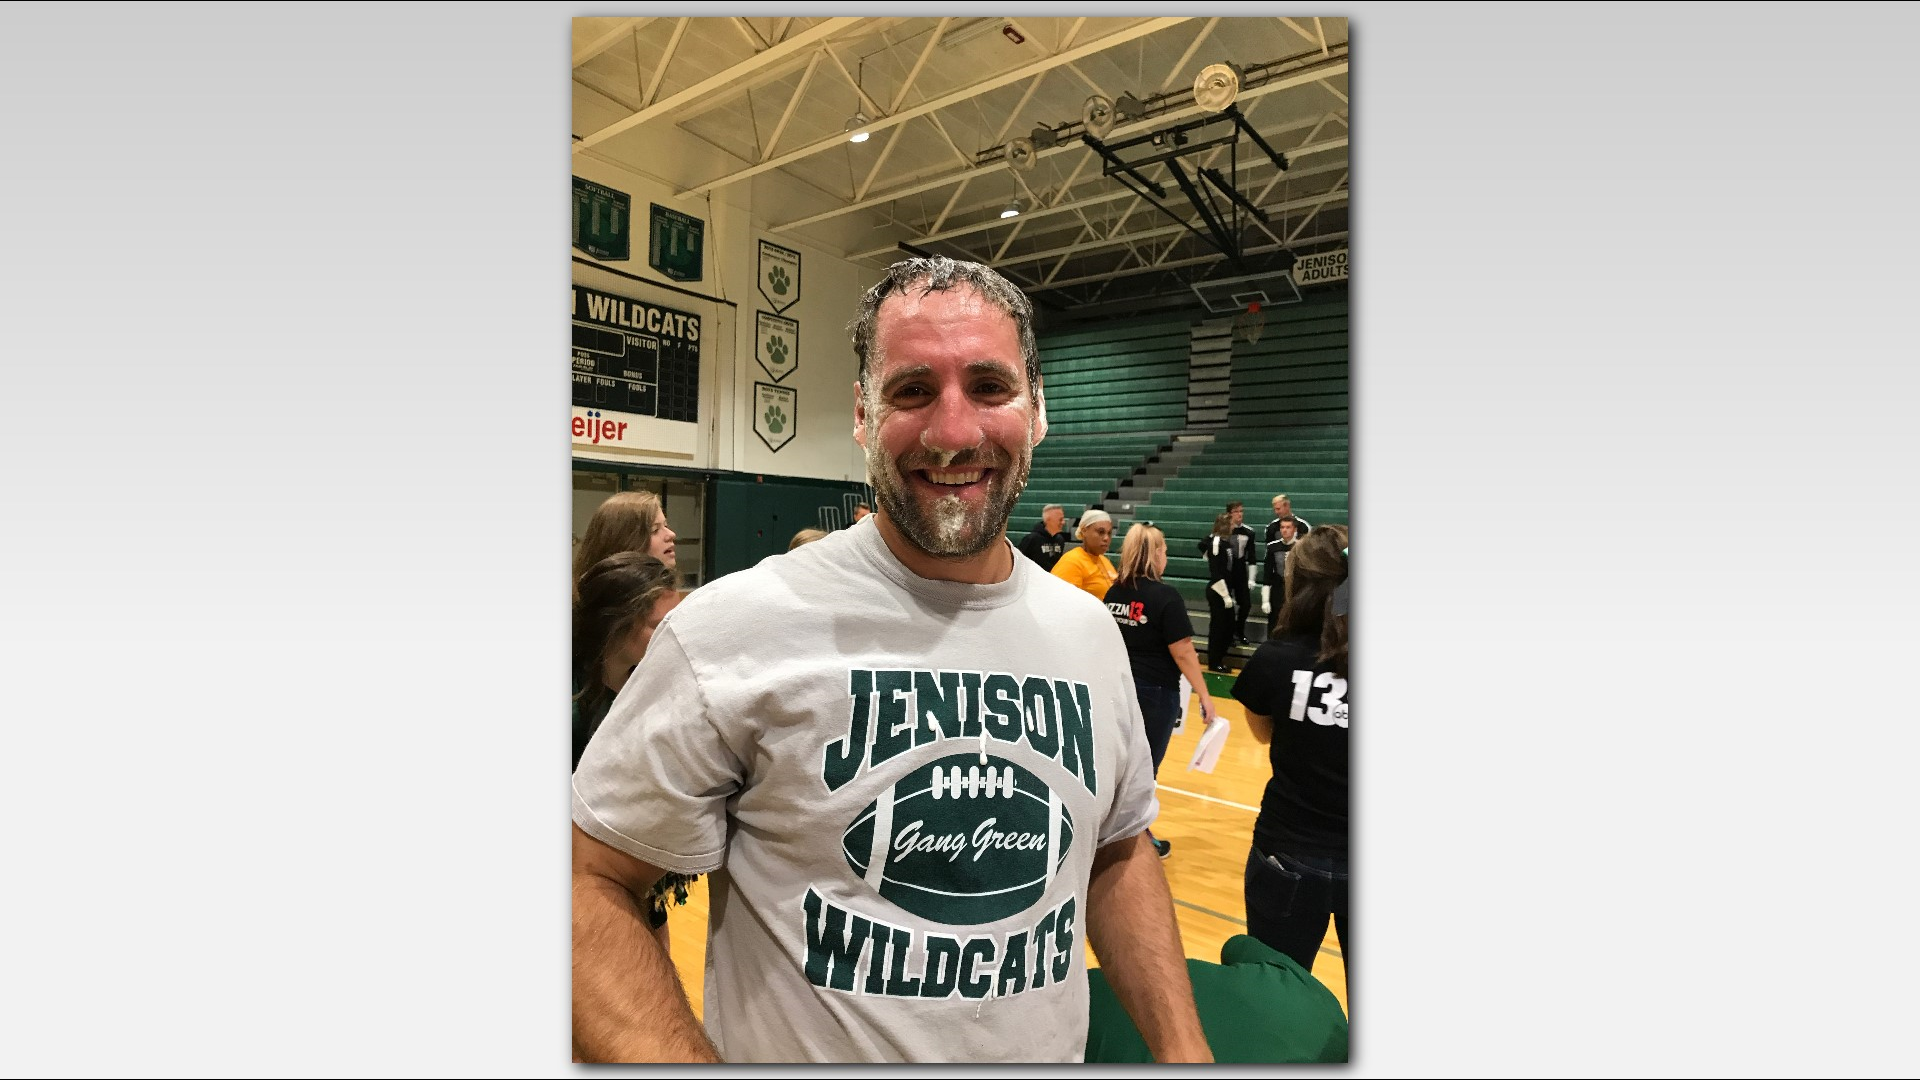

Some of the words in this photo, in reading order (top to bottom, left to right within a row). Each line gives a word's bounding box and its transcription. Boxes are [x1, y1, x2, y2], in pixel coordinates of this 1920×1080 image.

[585, 184, 615, 198] SOFTBALL
[586, 292, 699, 342] WILDCATS
[626, 335, 657, 351] VISITOR
[572, 356, 596, 367] PERIOD
[596, 378, 616, 388] FOULS
[623, 370, 643, 380] BONUS
[628, 383, 647, 393] FOULS
[1289, 670, 1348, 726] 13
[821, 669, 1097, 798] JENISON
[893, 819, 968, 863] Gang
[971, 818, 1047, 862] Green
[800, 882, 1077, 1001] WILDCATS
